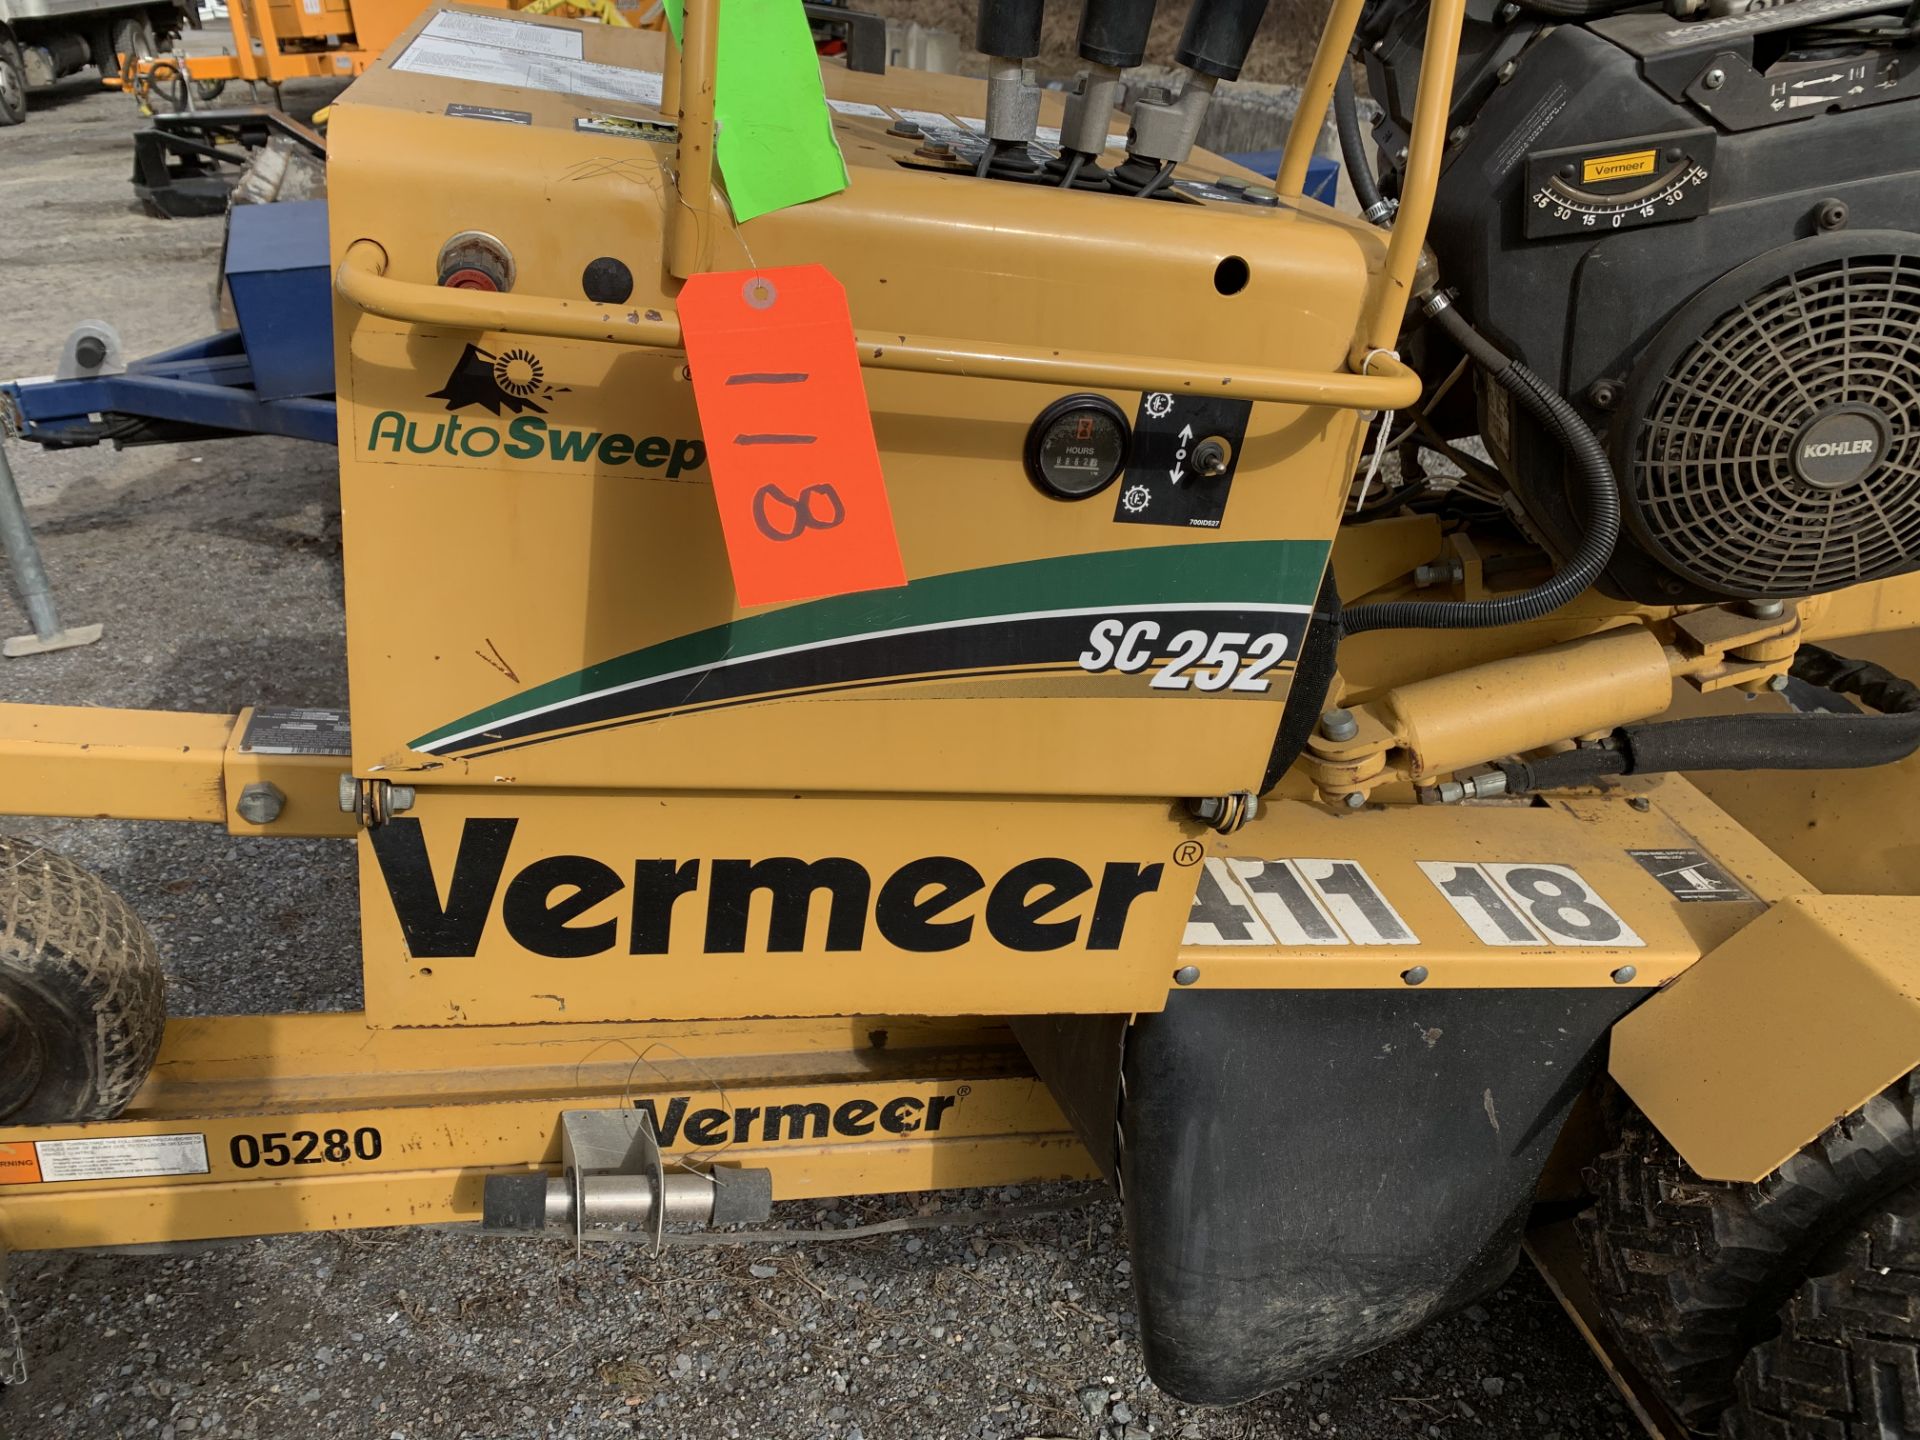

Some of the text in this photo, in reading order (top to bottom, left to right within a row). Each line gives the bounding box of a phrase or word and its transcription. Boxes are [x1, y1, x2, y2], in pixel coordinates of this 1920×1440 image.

[1665, 10, 1779, 37] KOHLER
[1595, 161, 1645, 175] Vermeer
[1532, 193, 1550, 209] 45
[1554, 207, 1571, 221] 30
[1582, 214, 1596, 226] 15
[1640, 204, 1655, 218] 15
[1665, 190, 1683, 206] 30
[1691, 169, 1708, 186] 45
[368, 411, 707, 478] AutoSweep
[1066, 446, 1095, 456] HOURS
[1804, 440, 1873, 458] KOHLER
[1078, 619, 1289, 692] SC 252
[371, 817, 1165, 959] Vermeer
[1440, 866, 1621, 942] 18
[230, 1127, 382, 1168] 05280
[634, 1094, 955, 1148] Vermeer
